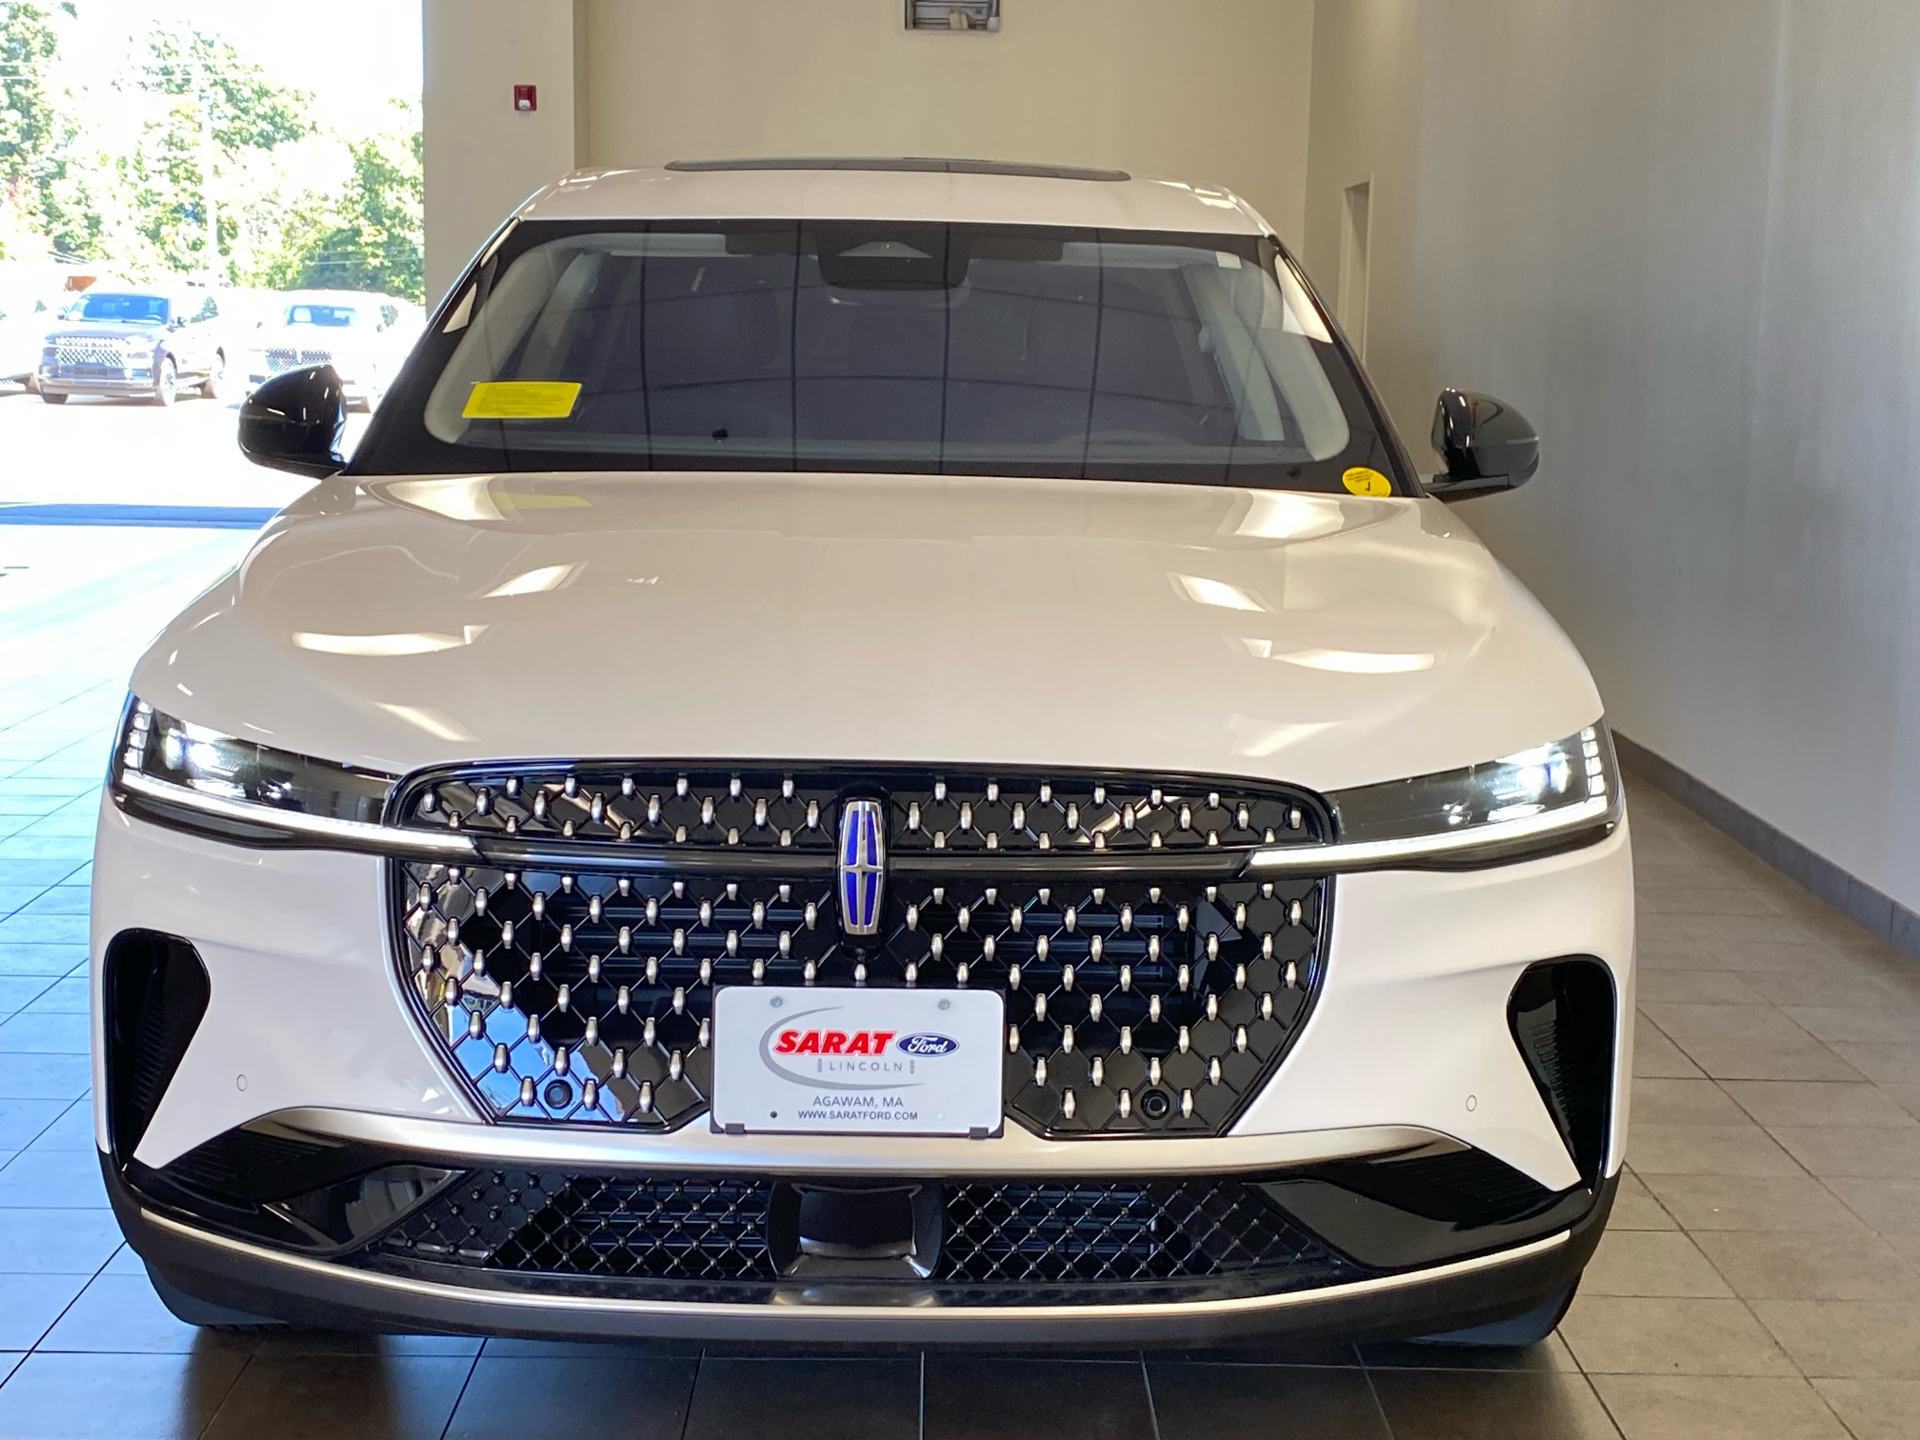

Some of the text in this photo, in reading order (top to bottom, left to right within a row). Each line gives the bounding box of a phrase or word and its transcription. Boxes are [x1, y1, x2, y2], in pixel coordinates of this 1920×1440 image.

[773, 1029, 948, 1056] SARAT Ford
[829, 1061, 902, 1072] LINCOLN
[812, 1096, 904, 1108] AGAWAM, MA
[797, 1110, 918, 1121] WWW.SARATFORD.COM
